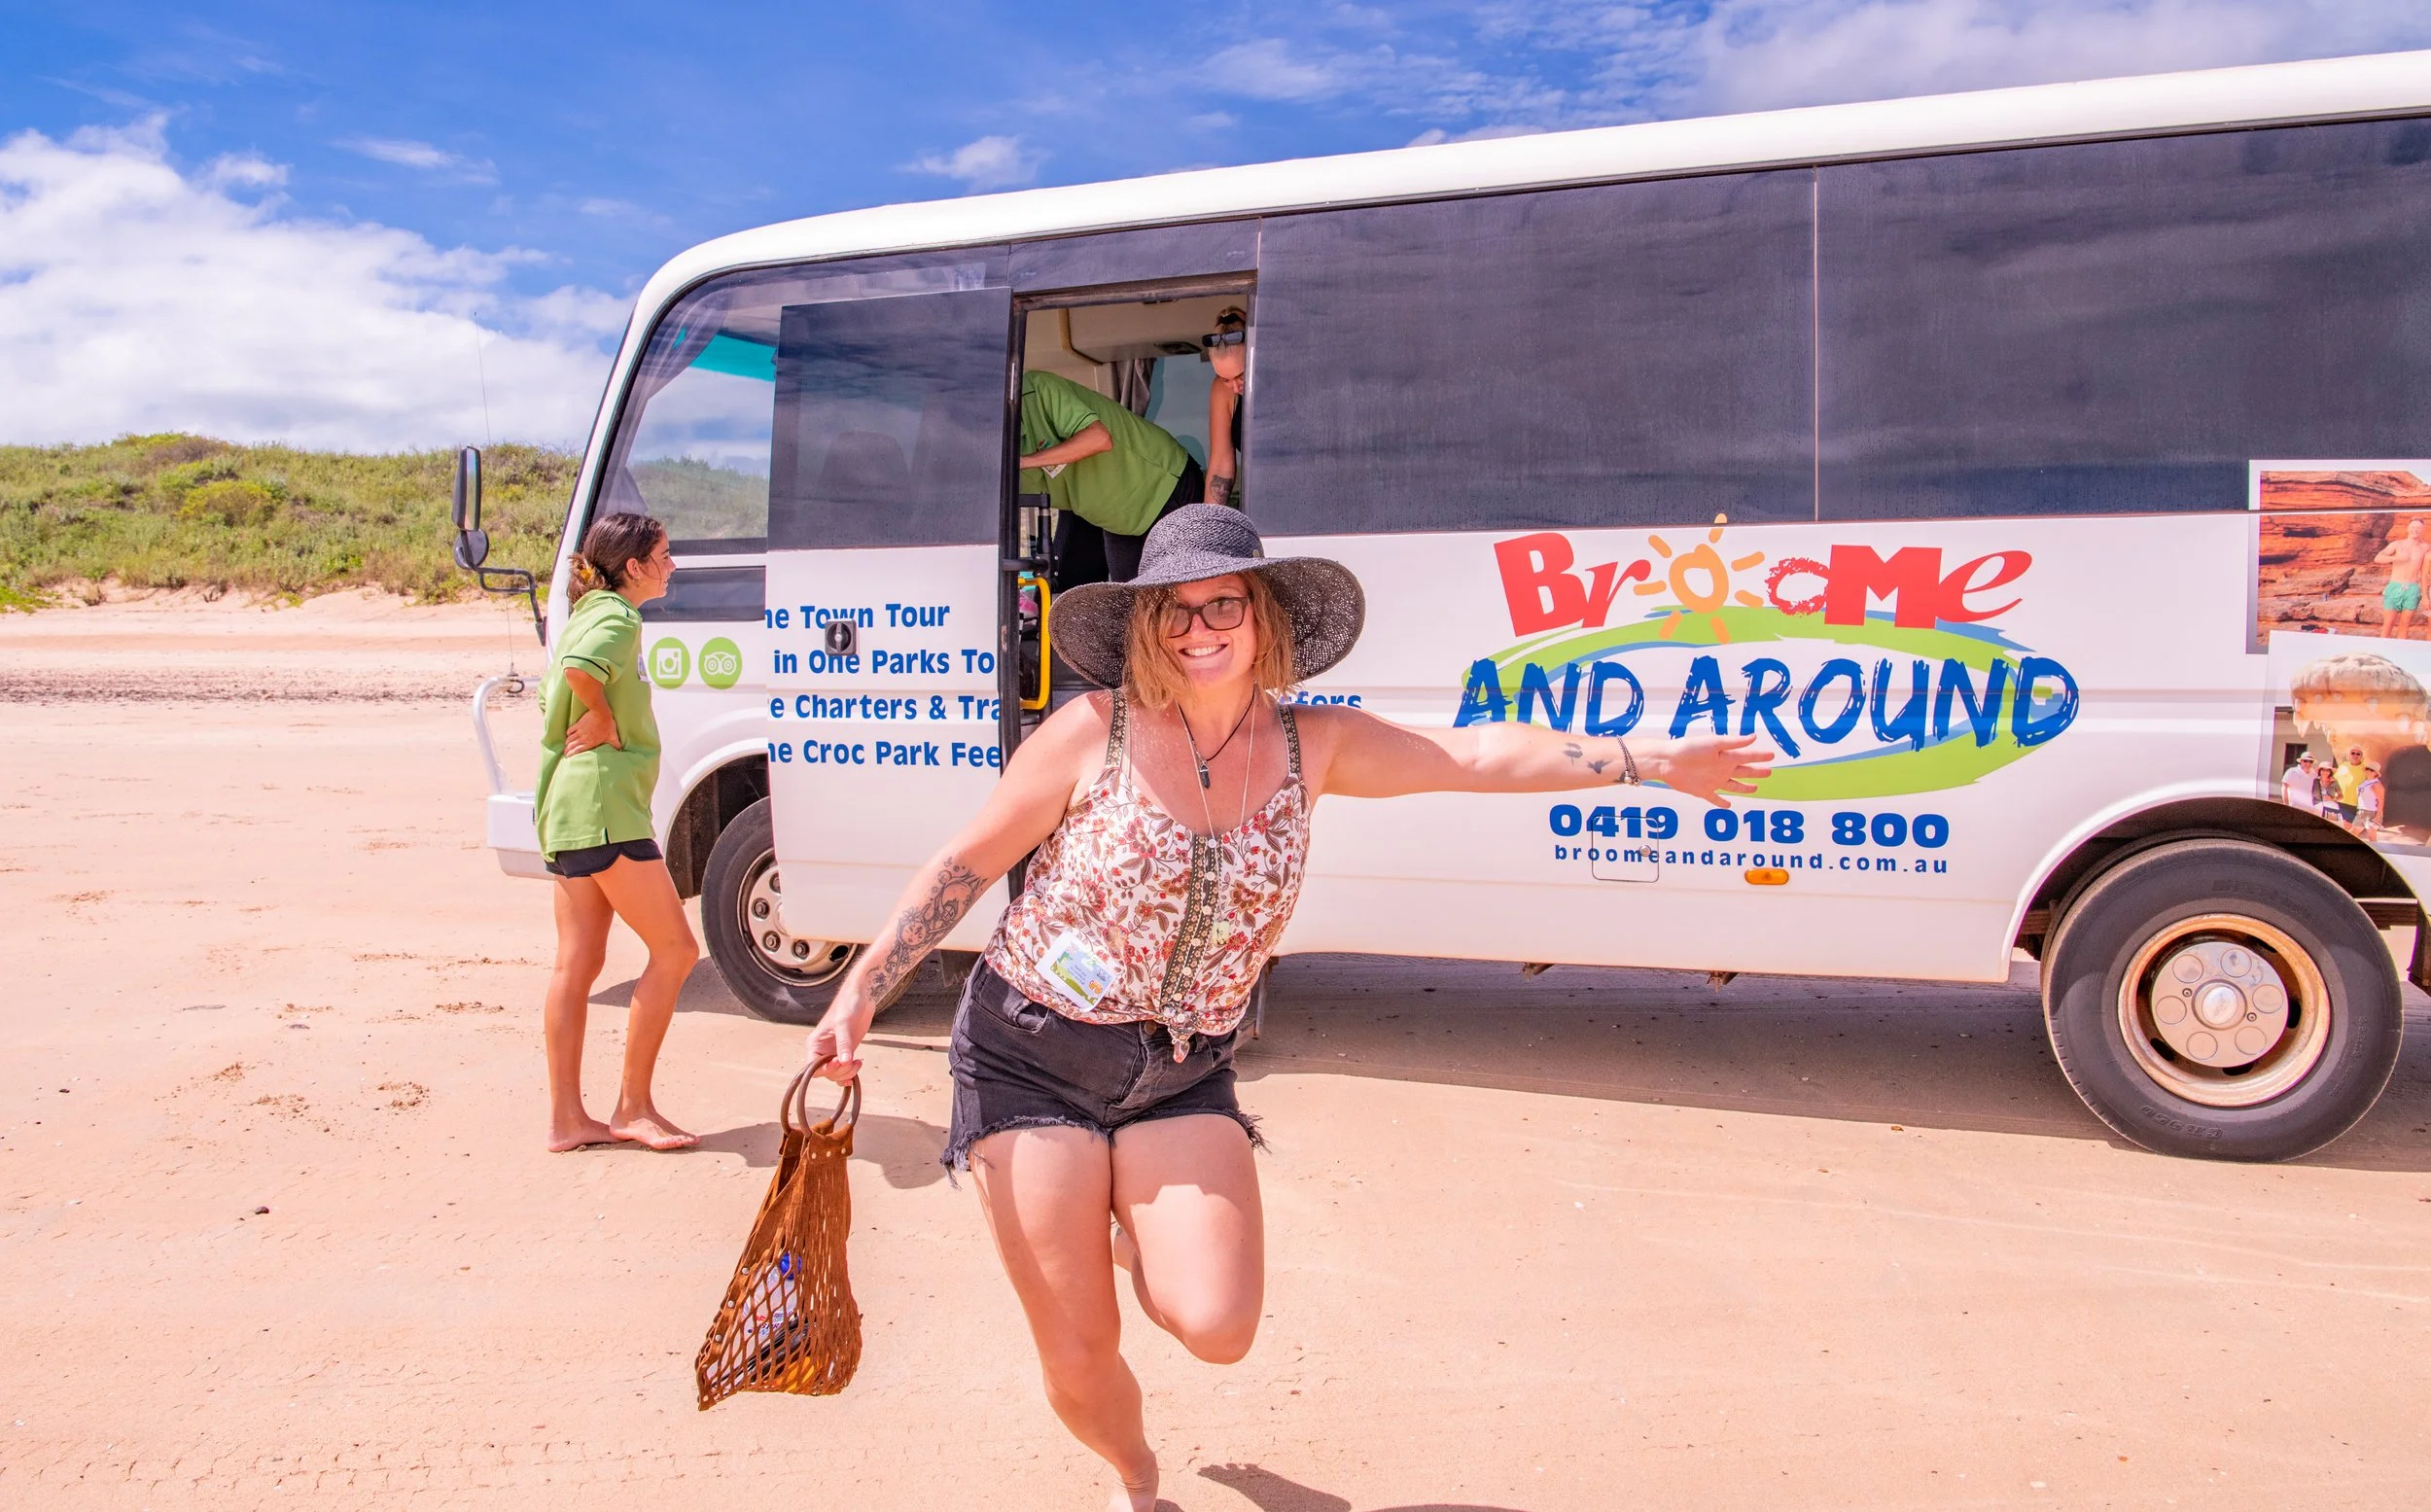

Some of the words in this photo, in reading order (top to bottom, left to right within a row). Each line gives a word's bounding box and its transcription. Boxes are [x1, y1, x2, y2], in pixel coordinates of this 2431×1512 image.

[800, 606, 873, 629] Town
[886, 603, 950, 627] Tour
[774, 650, 797, 673] in
[809, 650, 861, 674] One
[872, 650, 950, 674] Parks
[962, 649, 995, 674] To
[795, 694, 917, 720] Charters
[929, 695, 947, 720] &
[1453, 658, 1644, 738] AND
[1669, 653, 2079, 758] AROUND
[803, 740, 865, 764] Croc
[876, 741, 940, 765] Park
[951, 742, 1001, 767] Fee
[1549, 804, 1679, 840] 0419
[1704, 808, 1805, 844] 018
[1831, 811, 1950, 849] 800
[1555, 845, 1948, 873] broomeandaround.com.au
